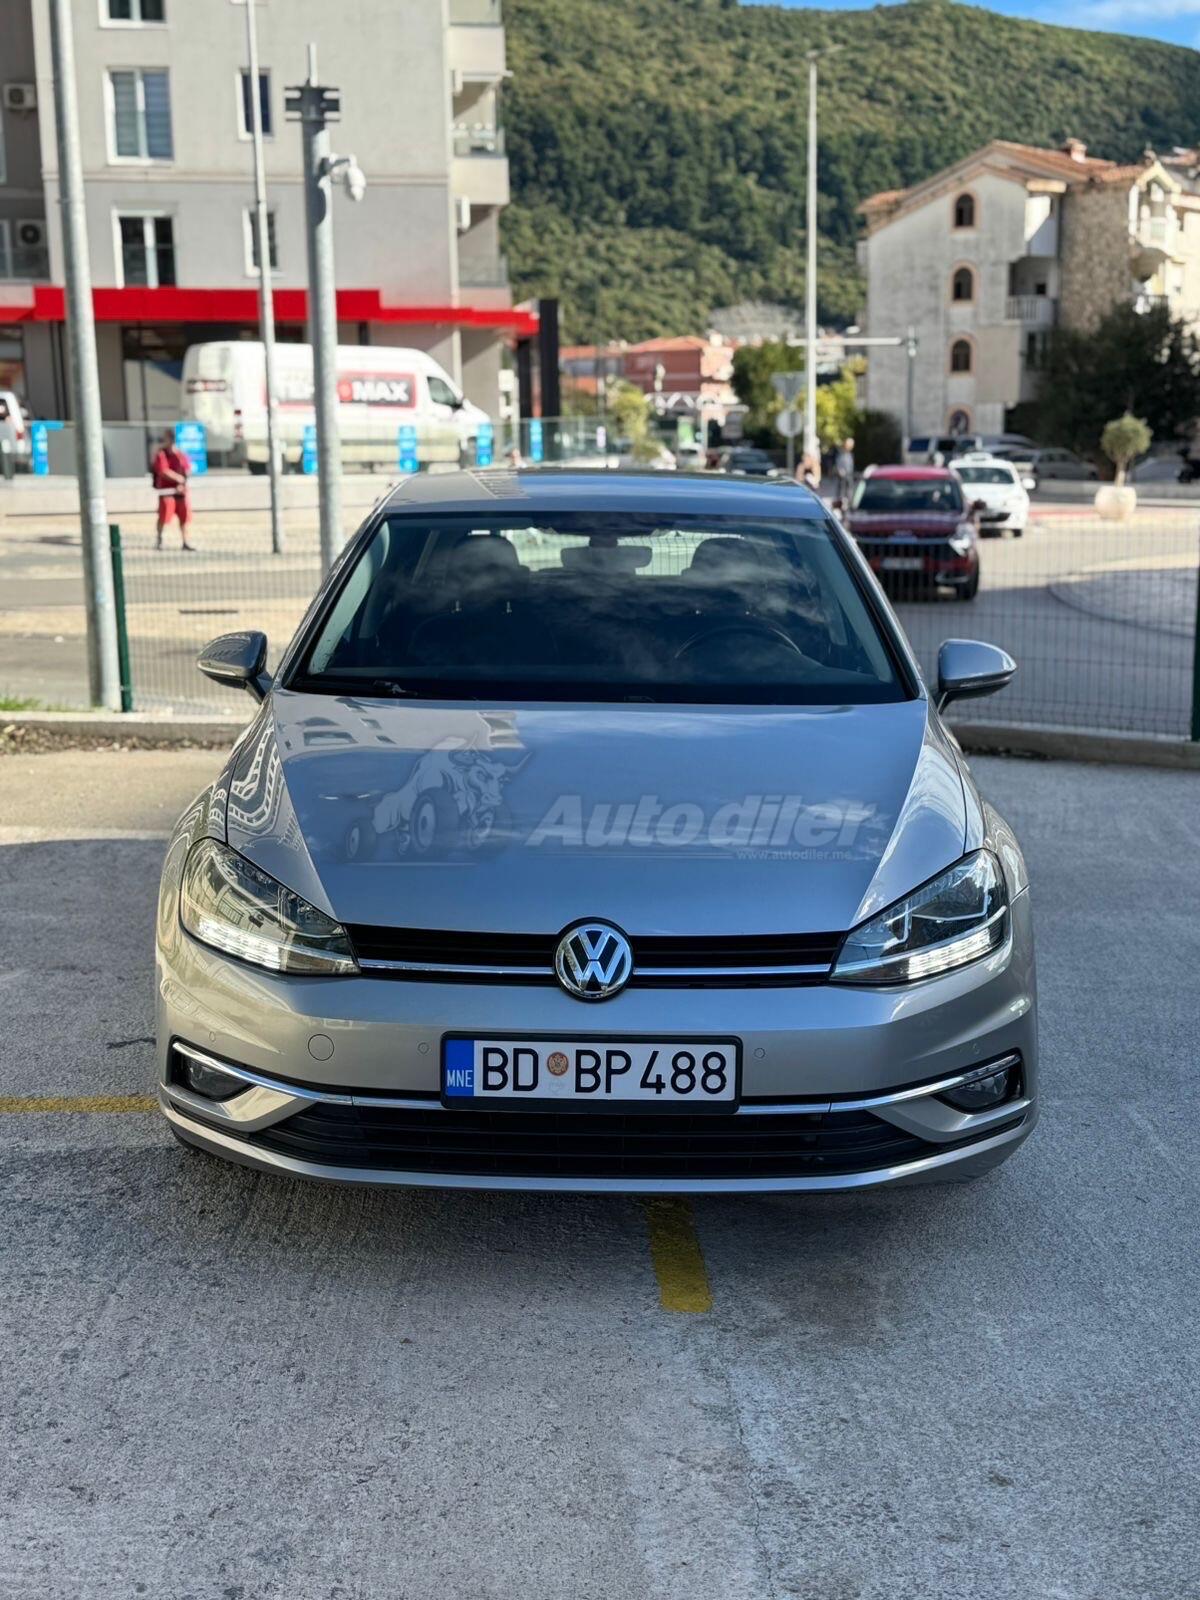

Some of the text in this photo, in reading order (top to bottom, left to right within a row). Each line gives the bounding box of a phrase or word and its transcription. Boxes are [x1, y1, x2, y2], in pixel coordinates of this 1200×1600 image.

[447, 1047, 727, 1094] MNE BD BP 488
